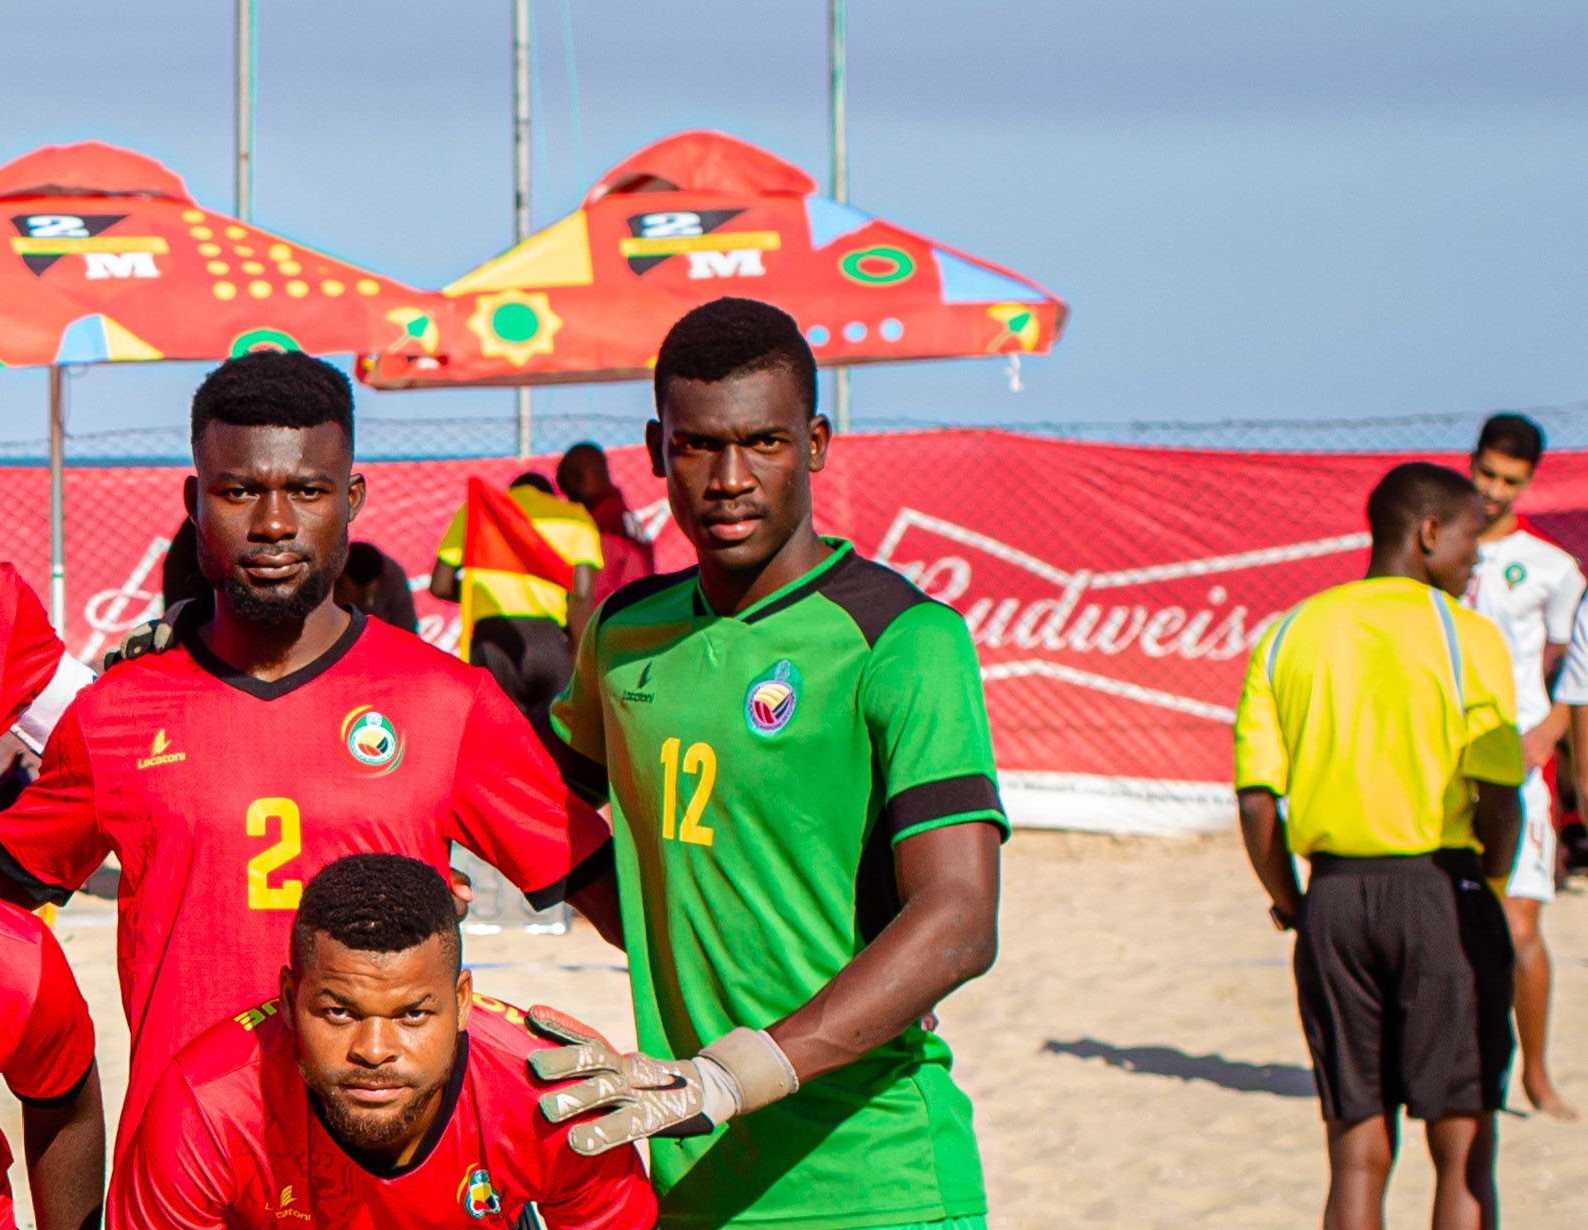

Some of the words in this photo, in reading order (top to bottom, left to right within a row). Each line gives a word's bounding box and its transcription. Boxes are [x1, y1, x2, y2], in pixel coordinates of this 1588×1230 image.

[26, 215, 90, 238] 2
[642, 212, 703, 239] 2
[85, 252, 160, 279] M
[687, 249, 765, 279] M
[137, 752, 186, 770] Lacatoni
[659, 736, 717, 846] 12
[246, 797, 304, 911] 2
